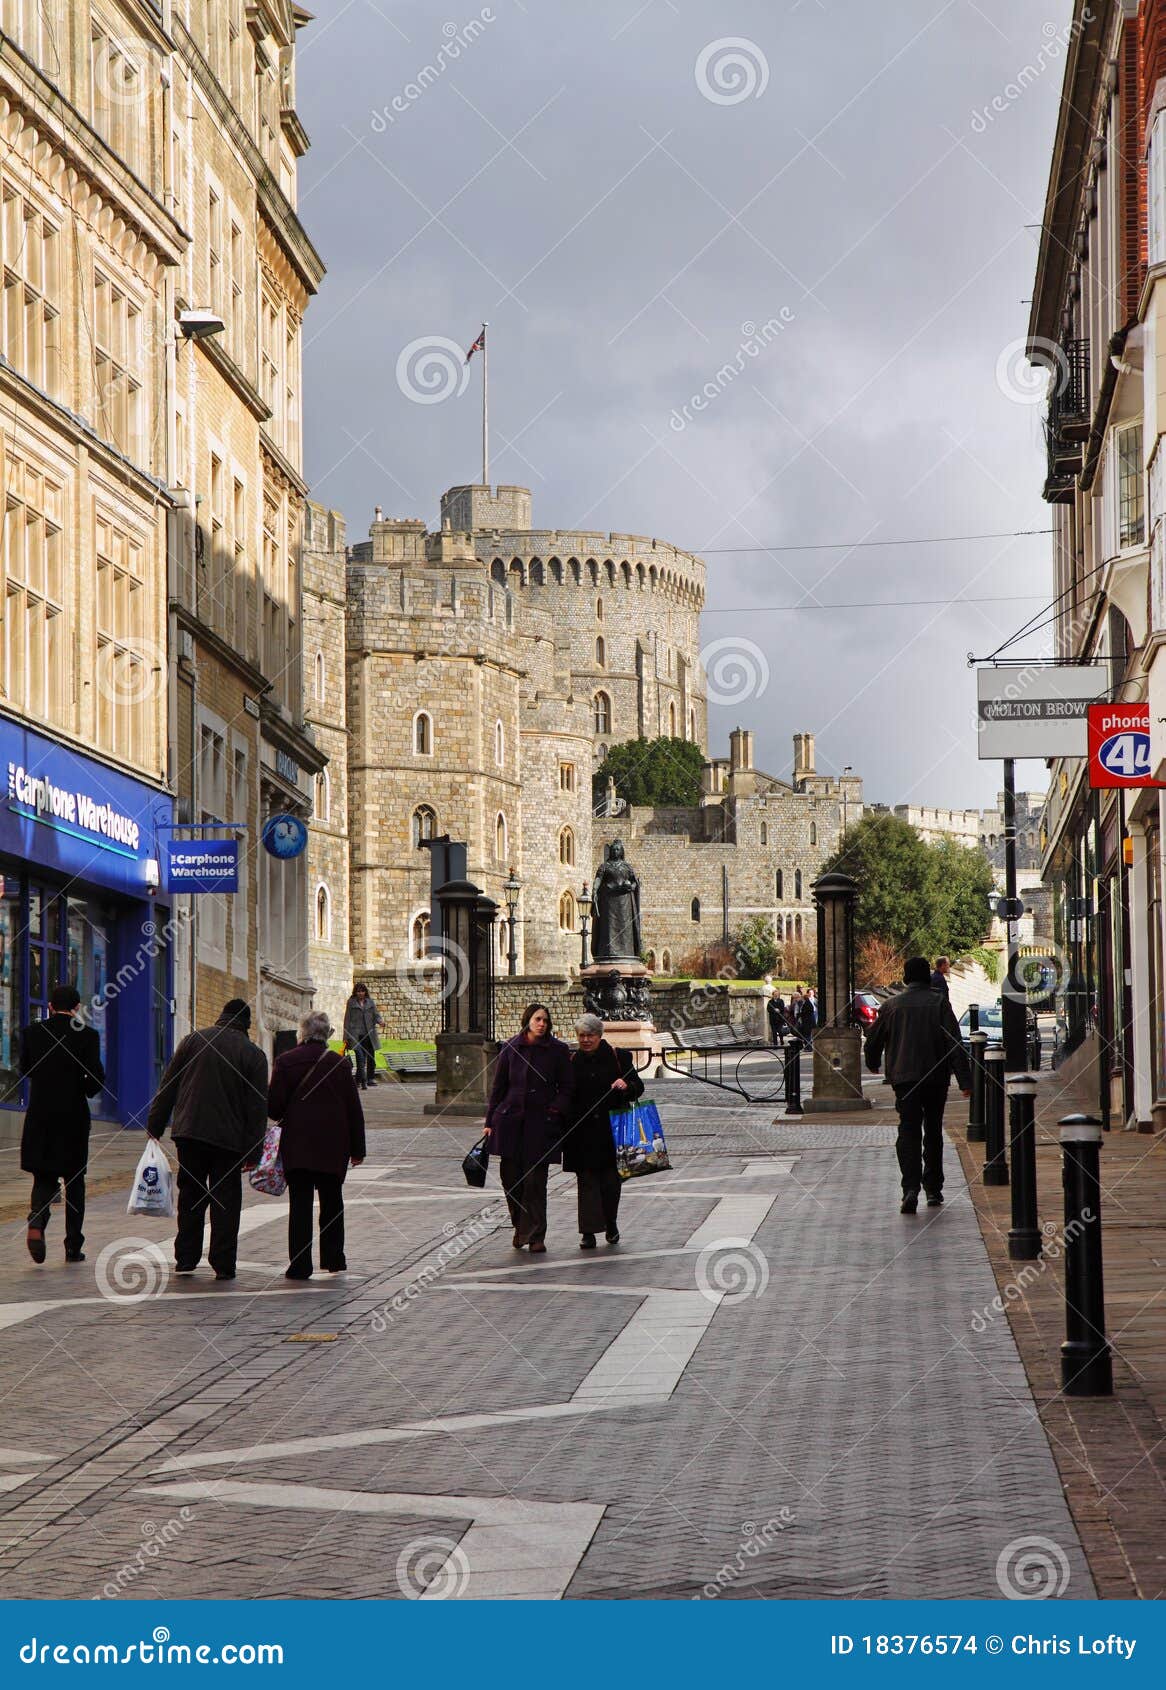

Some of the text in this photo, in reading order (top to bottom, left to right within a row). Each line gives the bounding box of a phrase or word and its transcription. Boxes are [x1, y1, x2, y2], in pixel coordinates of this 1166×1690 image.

[990, 702, 1097, 717] MOLTON BROW
[1102, 714, 1149, 731] phone
[16, 766, 75, 823] Carphone
[77, 793, 139, 850] Warehouse
[177, 854, 235, 866] Carphone
[172, 867, 235, 877] Warehouse
